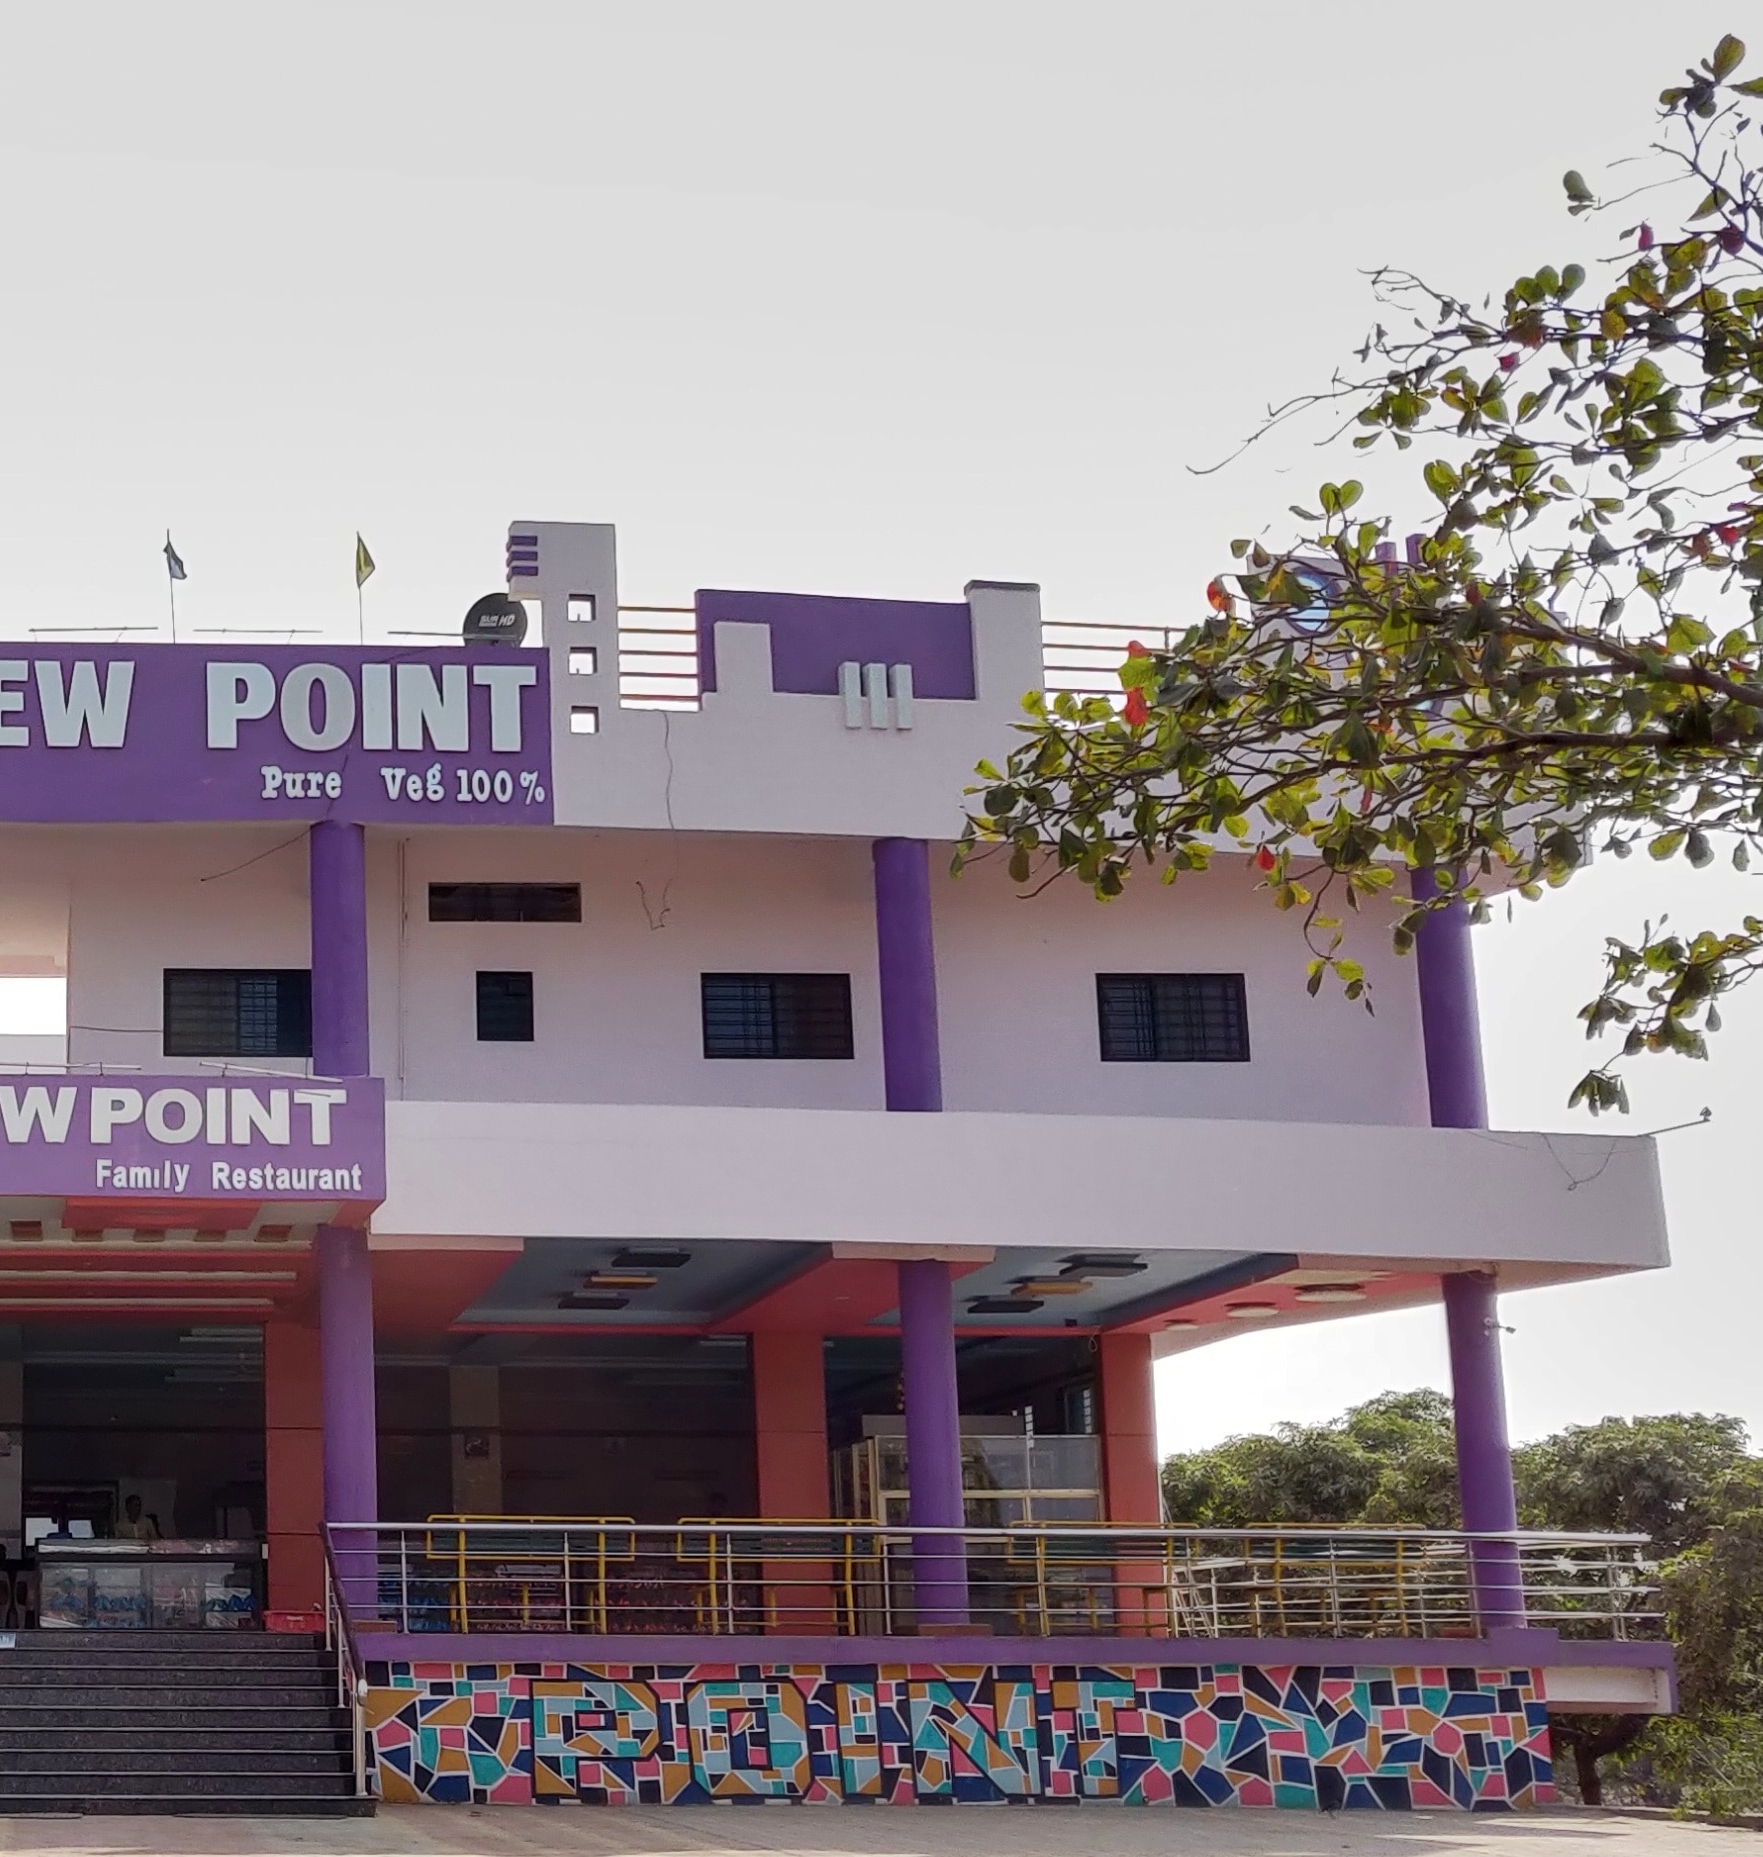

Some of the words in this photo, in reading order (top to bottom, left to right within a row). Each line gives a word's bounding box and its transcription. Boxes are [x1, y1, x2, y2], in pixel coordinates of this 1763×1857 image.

[205, 661, 537, 752] POINT
[260, 765, 342, 799] Pure
[380, 763, 445, 802] Veg
[89, 1087, 348, 1146] POINT
[96, 1158, 190, 1193] Family
[212, 1161, 363, 1192] Restaurant
[530, 1677, 1140, 1800] POINT
